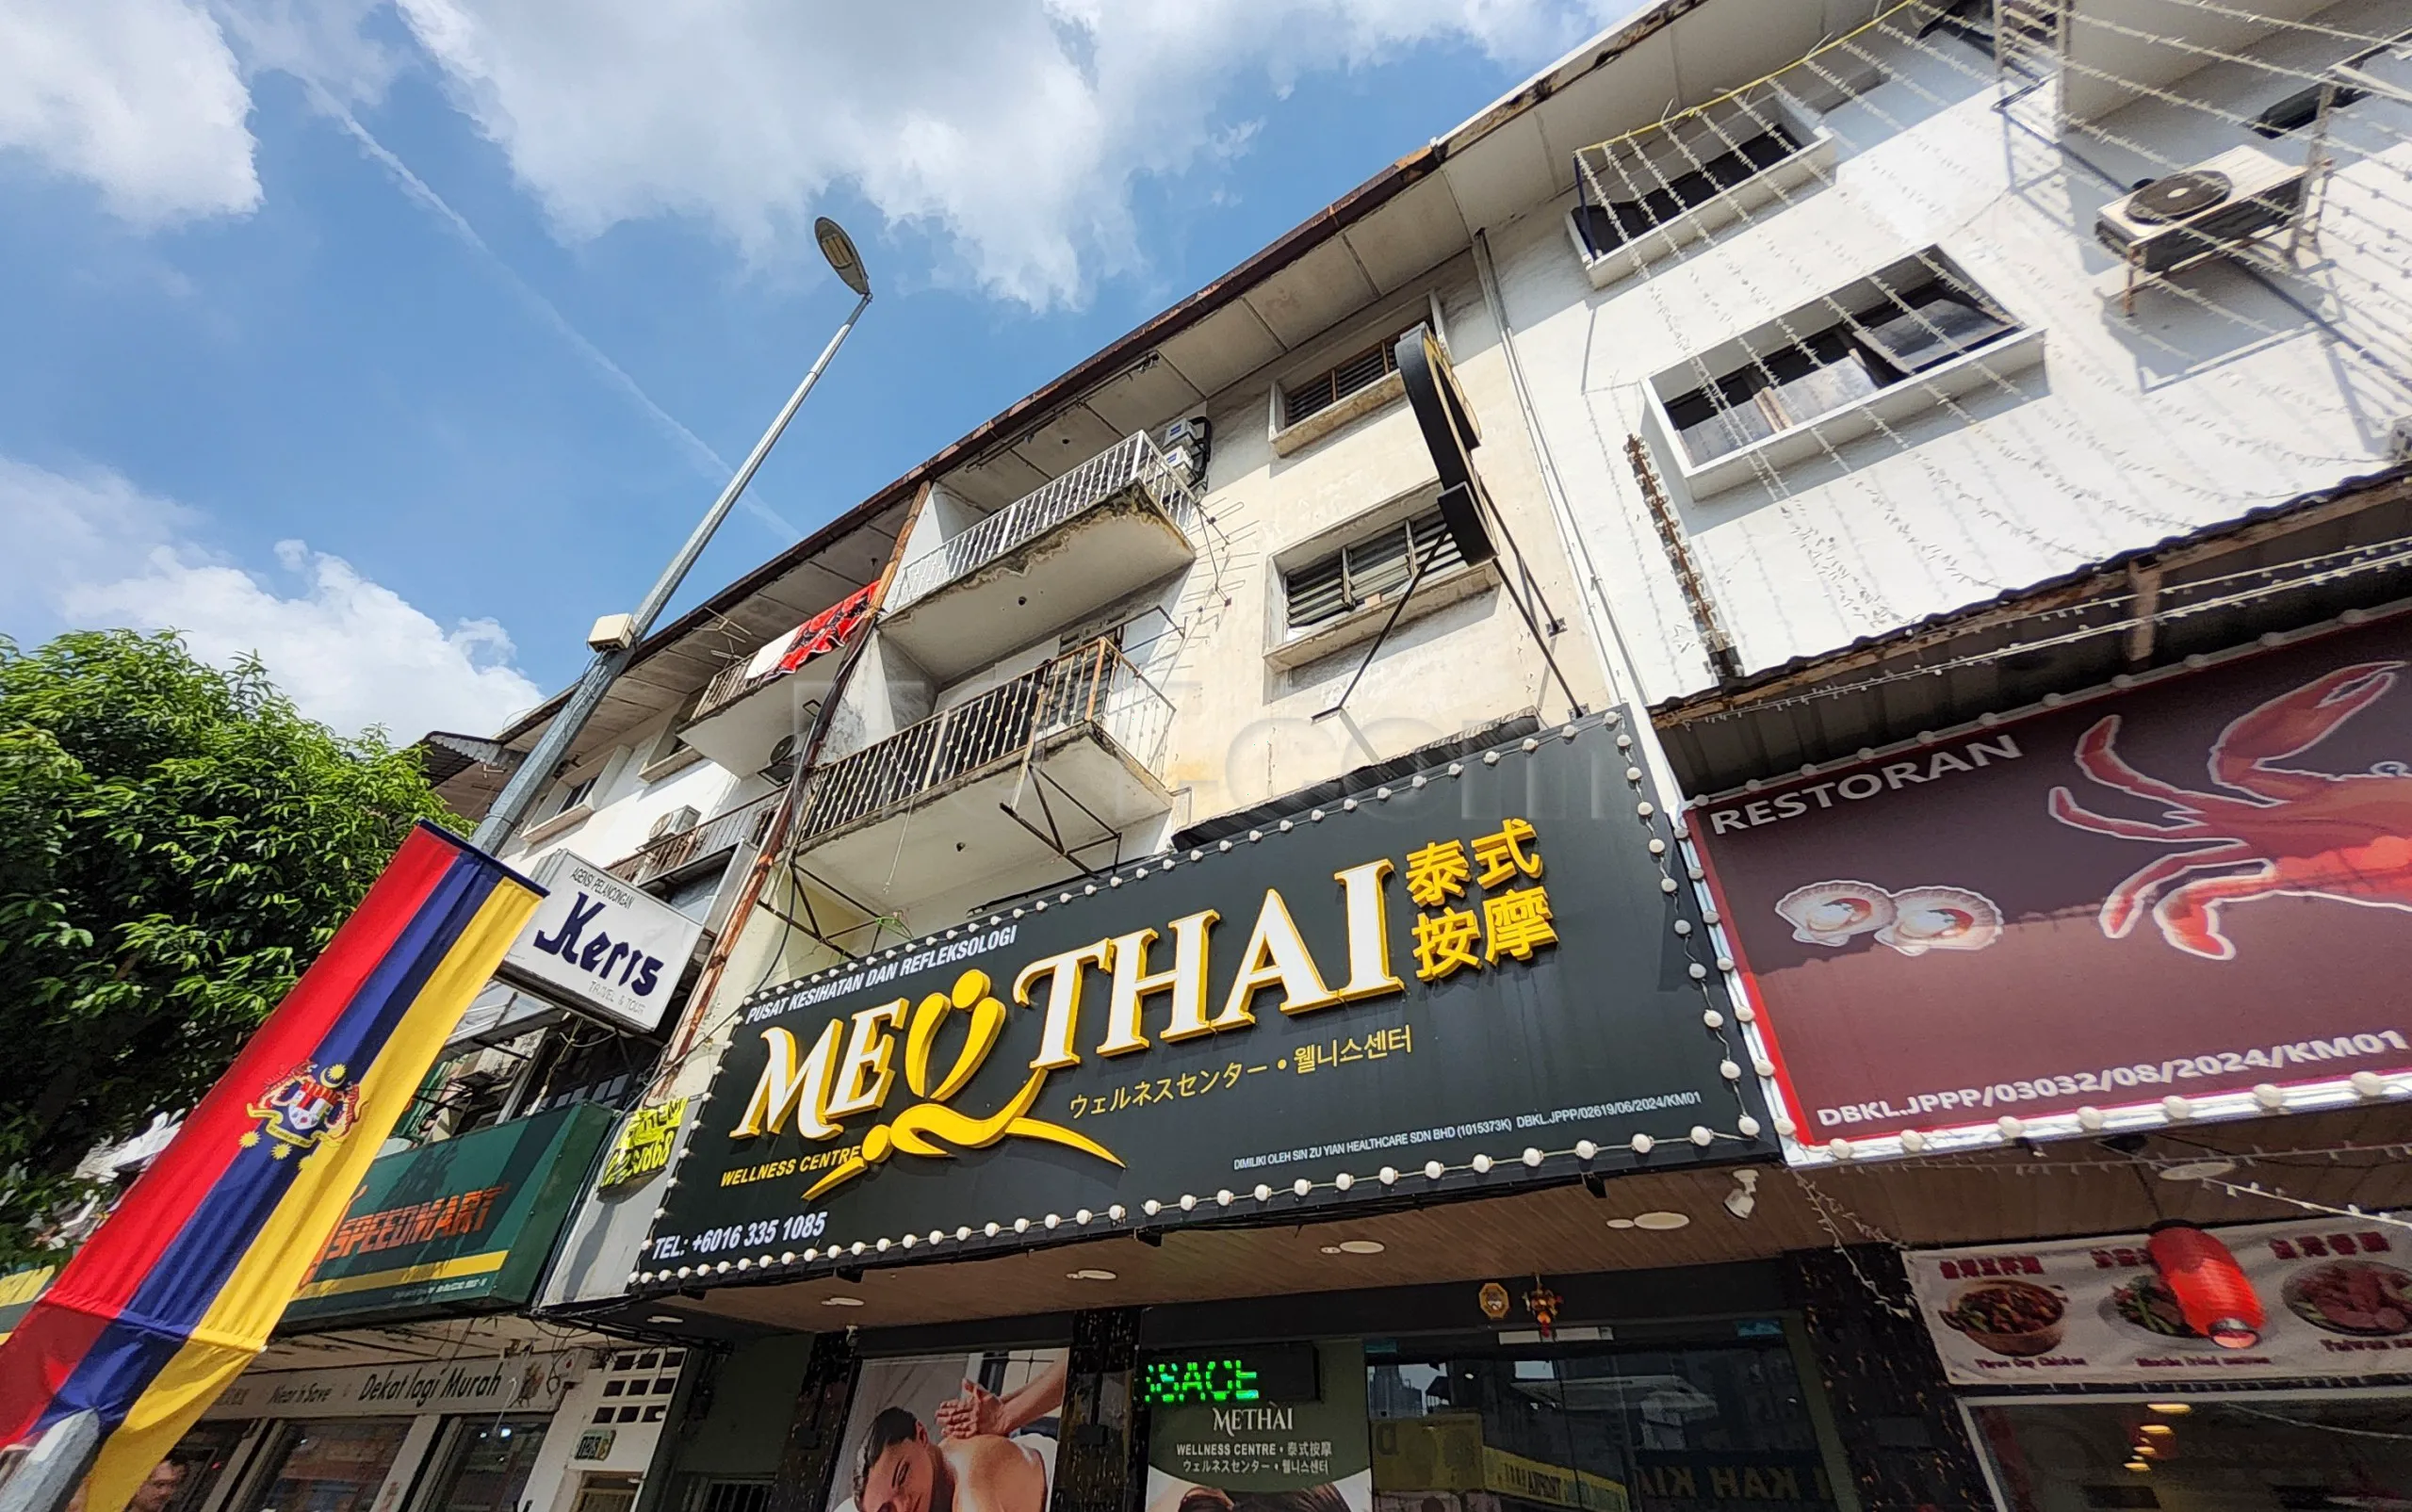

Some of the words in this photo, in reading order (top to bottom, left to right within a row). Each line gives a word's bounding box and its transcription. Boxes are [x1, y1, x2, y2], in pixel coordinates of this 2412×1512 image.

[1710, 734, 2023, 835] RESTORAN
[570, 866, 595, 888] AGENSI
[1406, 819, 1542, 907] 泰式
[532, 891, 664, 997] Keris
[1410, 886, 1558, 982] 按摩
[745, 996, 790, 1025] PUSAT
[789, 973, 862, 1011] KESIHATAN
[865, 961, 900, 986] DAN
[900, 925, 1018, 978] REFLEKSOLOGI
[1293, 1025, 1412, 1074] 웰니스센터
[1068, 1062, 1268, 1119] ウェルネスセンター
[720, 1158, 796, 1187] WELLNESS
[799, 1145, 861, 1172] CENTRE
[1233, 1154, 1266, 1171] DIMILIKI
[1267, 1148, 1292, 1164] OLEH
[1292, 1147, 1308, 1162] SIN
[1309, 1146, 1323, 1159] ZU
[1323, 1143, 1345, 1156] YIAN
[1346, 1133, 1409, 1153] HEALTHCARE
[1410, 1129, 1431, 1144] SDN
[1432, 1125, 1456, 1141] BHD
[1458, 1117, 1512, 1139] (1015373K)
[327, 1185, 503, 1260] SPEEDMART
[652, 1234, 689, 1260] TEL:
[692, 1225, 743, 1254] +6016
[743, 1219, 779, 1246] 335
[782, 1211, 828, 1242] 1085
[358, 1369, 409, 1401] Dekat
[403, 1367, 446, 1407] lagi
[439, 1361, 503, 1398] Murah
[1176, 1443, 1230, 1456] WELLNESS
[1233, 1442, 1277, 1455] CENTRE
[1287, 1441, 1332, 1456] 泰式按摩
